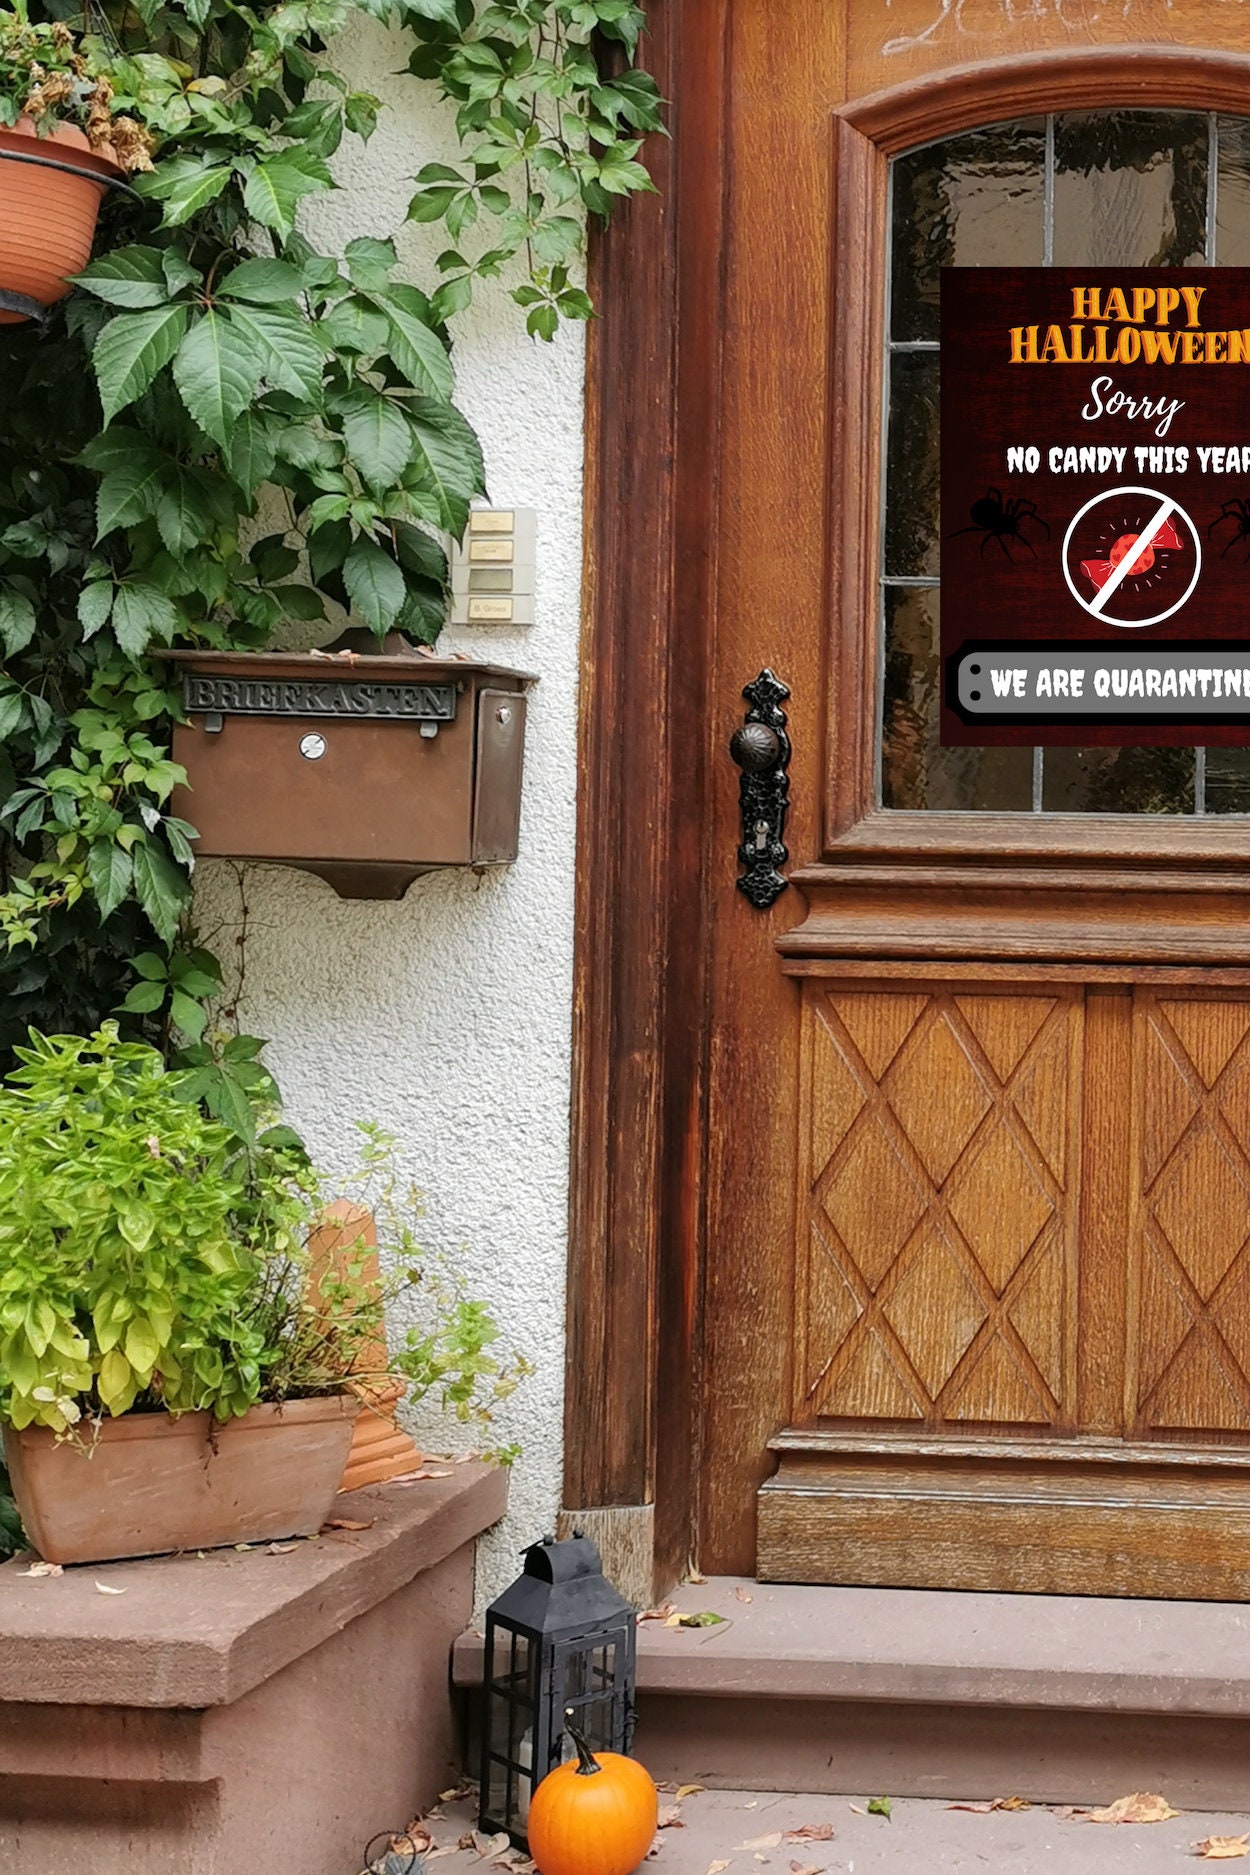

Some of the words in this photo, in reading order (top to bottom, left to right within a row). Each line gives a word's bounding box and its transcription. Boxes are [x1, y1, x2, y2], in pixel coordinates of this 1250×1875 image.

[1070, 287, 1207, 327] HAPPY
[1081, 376, 1186, 437] Sorry
[1006, 446, 1041, 474] NO
[1048, 446, 1128, 474] CANDY
[1133, 445, 1190, 474] THIS
[190, 678, 451, 717] BRIEFKASTEN
[989, 668, 1028, 698] WE
[1035, 668, 1086, 698] ARE
